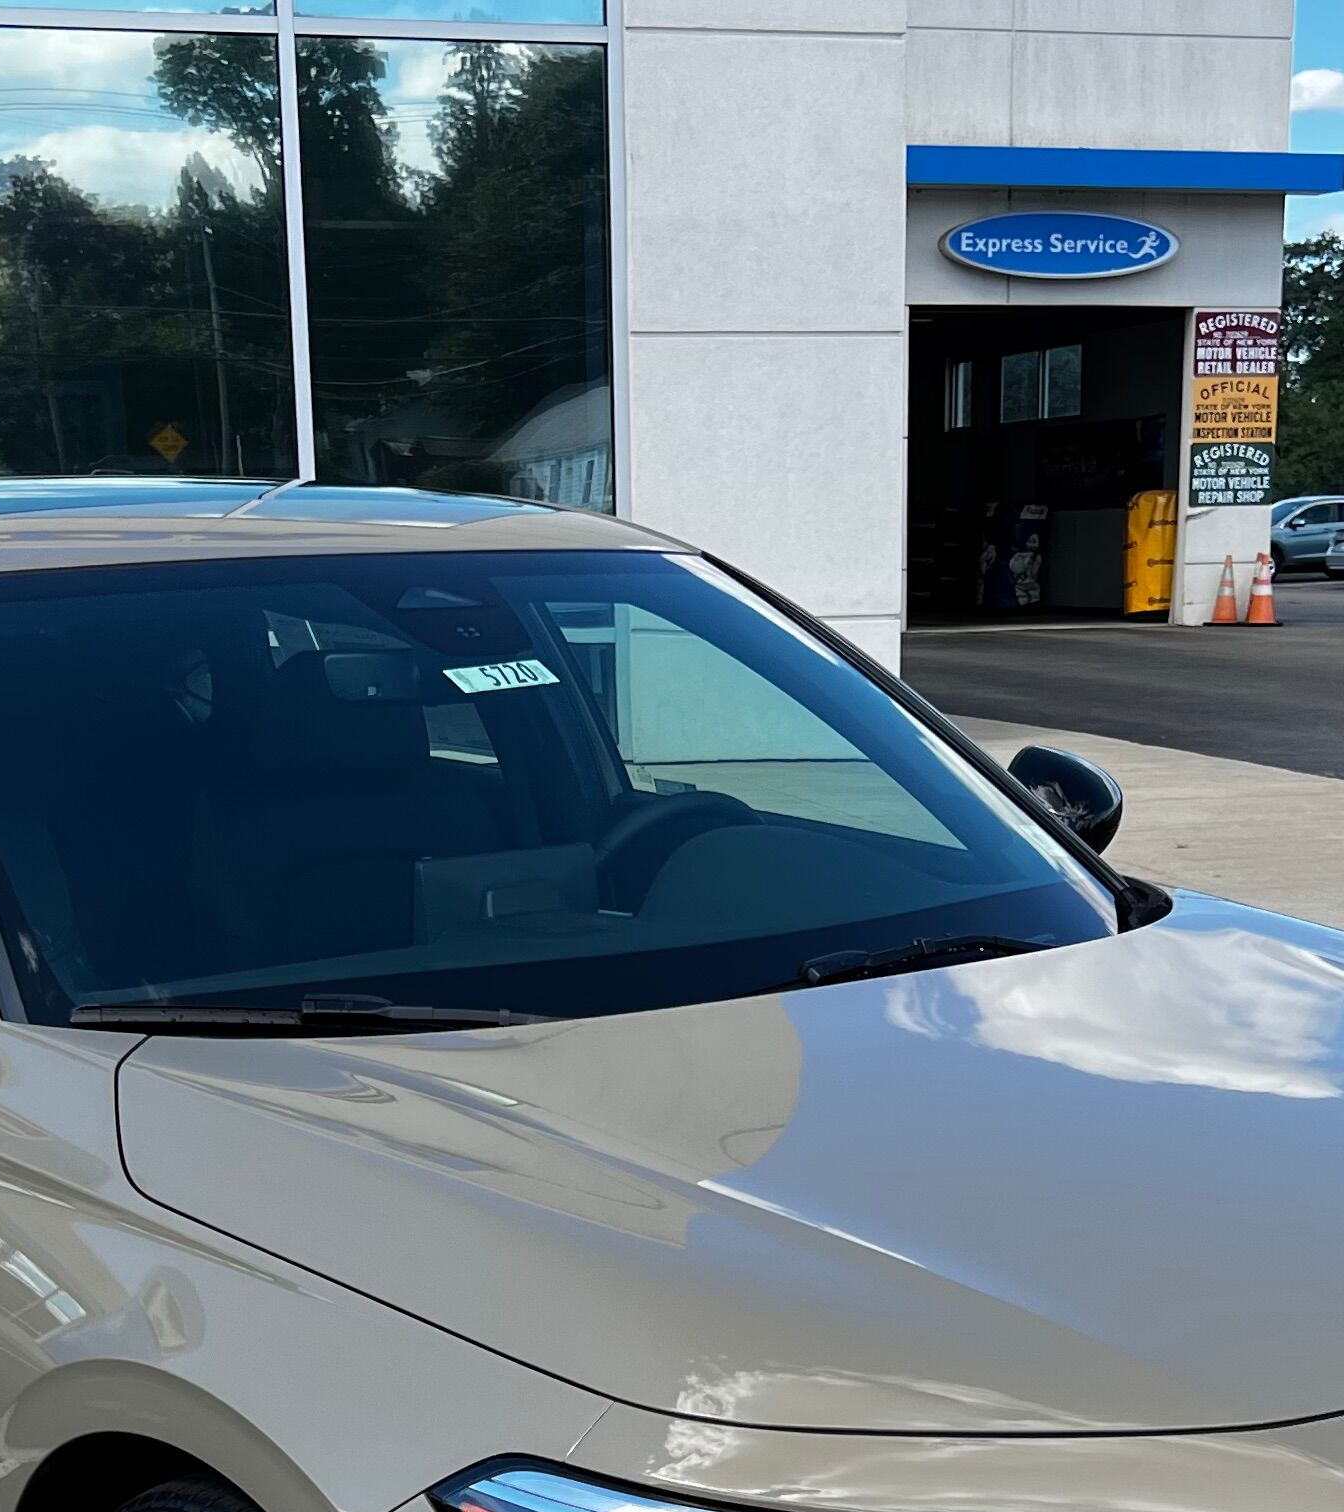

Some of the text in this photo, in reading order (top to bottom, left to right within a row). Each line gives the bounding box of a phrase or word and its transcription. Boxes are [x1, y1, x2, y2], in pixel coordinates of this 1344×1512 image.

[960, 231, 1129, 258] Express Service
[1198, 313, 1278, 336] REGISTERED
[1197, 338, 1221, 346] STATE
[1196, 347, 1278, 360] MOTOR VEHICLE
[1197, 361, 1276, 374] RETAIL DEALER
[1199, 380, 1270, 400] OFFICIAL
[1194, 411, 1272, 423] MOTOR VEHICLE
[1192, 427, 1272, 439] INSPECTION STATION
[1193, 443, 1271, 468] REGISTERED
[1193, 468, 1216, 476] STATE
[1192, 476, 1271, 490] MOTOR VEHICLE
[1198, 490, 1265, 504] REPAIR SHOP
[478, 662, 539, 687] 5720
